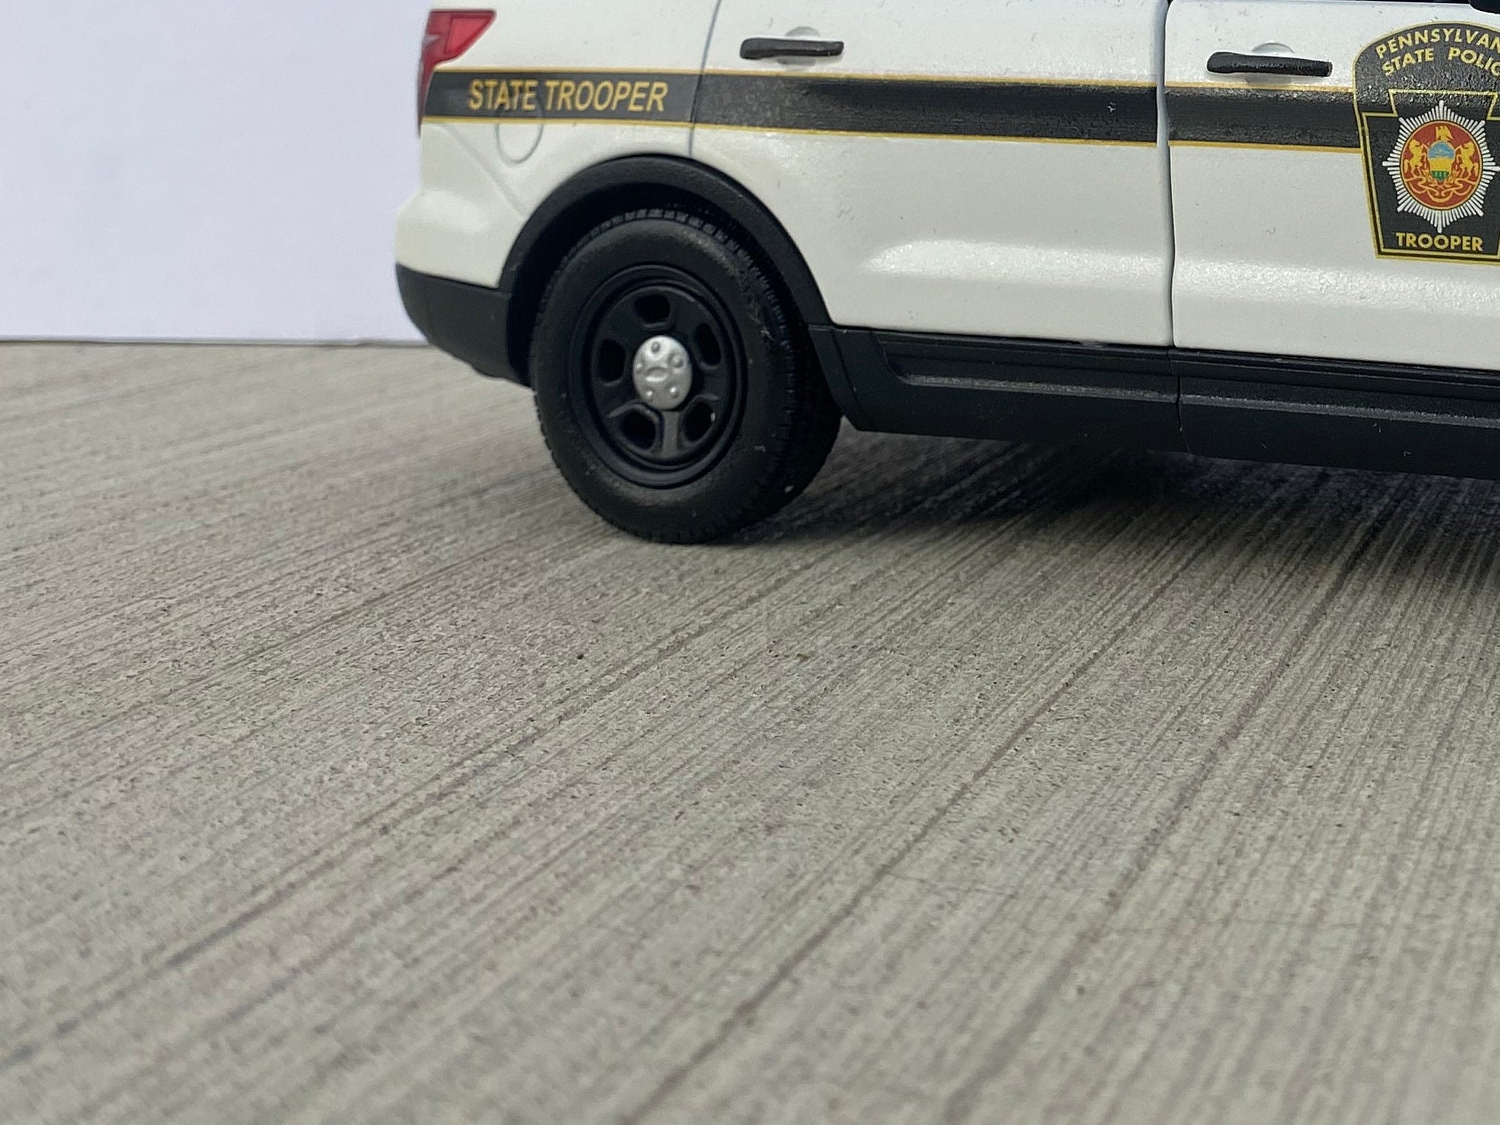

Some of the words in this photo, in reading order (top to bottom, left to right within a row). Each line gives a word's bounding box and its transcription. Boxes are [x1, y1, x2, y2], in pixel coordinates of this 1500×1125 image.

[1382, 48, 1434, 76] STATE
[468, 78, 538, 111] STATE
[545, 79, 669, 112] TROOPER
[1396, 232, 1483, 252] TROOPER
